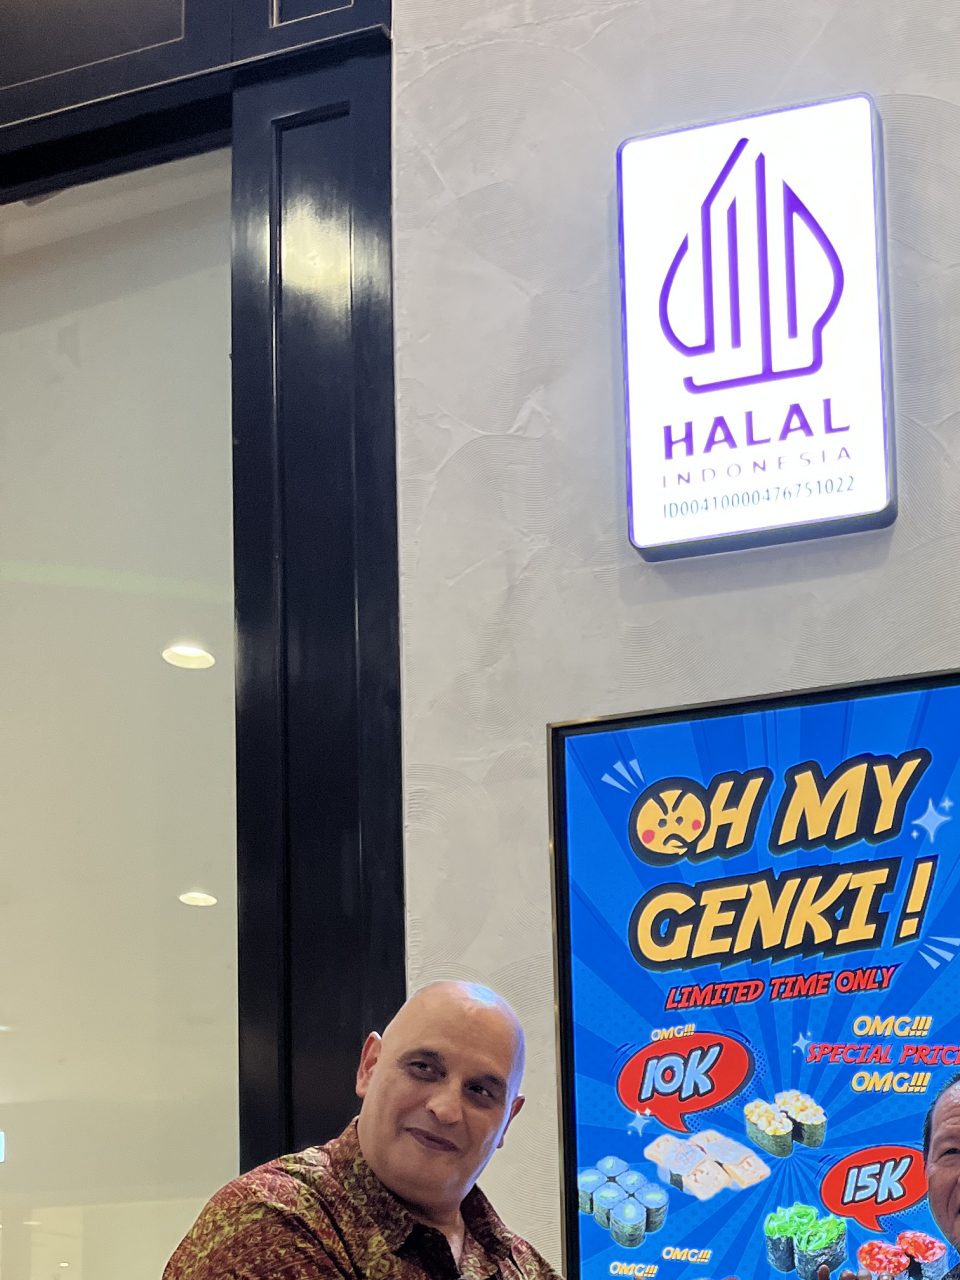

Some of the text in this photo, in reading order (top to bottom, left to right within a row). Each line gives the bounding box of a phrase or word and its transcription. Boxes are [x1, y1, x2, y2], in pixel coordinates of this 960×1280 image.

[663, 398, 850, 460] HALAL
[662, 446, 851, 488] INDONESIA
[777, 757, 922, 846] MY
[637, 868, 889, 962] GENKI
[665, 964, 899, 1010] LIMITED TIME ONLY
[650, 1023, 696, 1042] OMG!!!
[853, 1015, 932, 1037] OMG!!!
[640, 1045, 722, 1100] 10K
[806, 1043, 893, 1065] SPECIAL
[851, 1071, 931, 1094] OMG!!!
[843, 1159, 912, 1203] 15K
[609, 1261, 658, 1278] OMG!!!
[662, 1246, 712, 1263] OMG!!!
